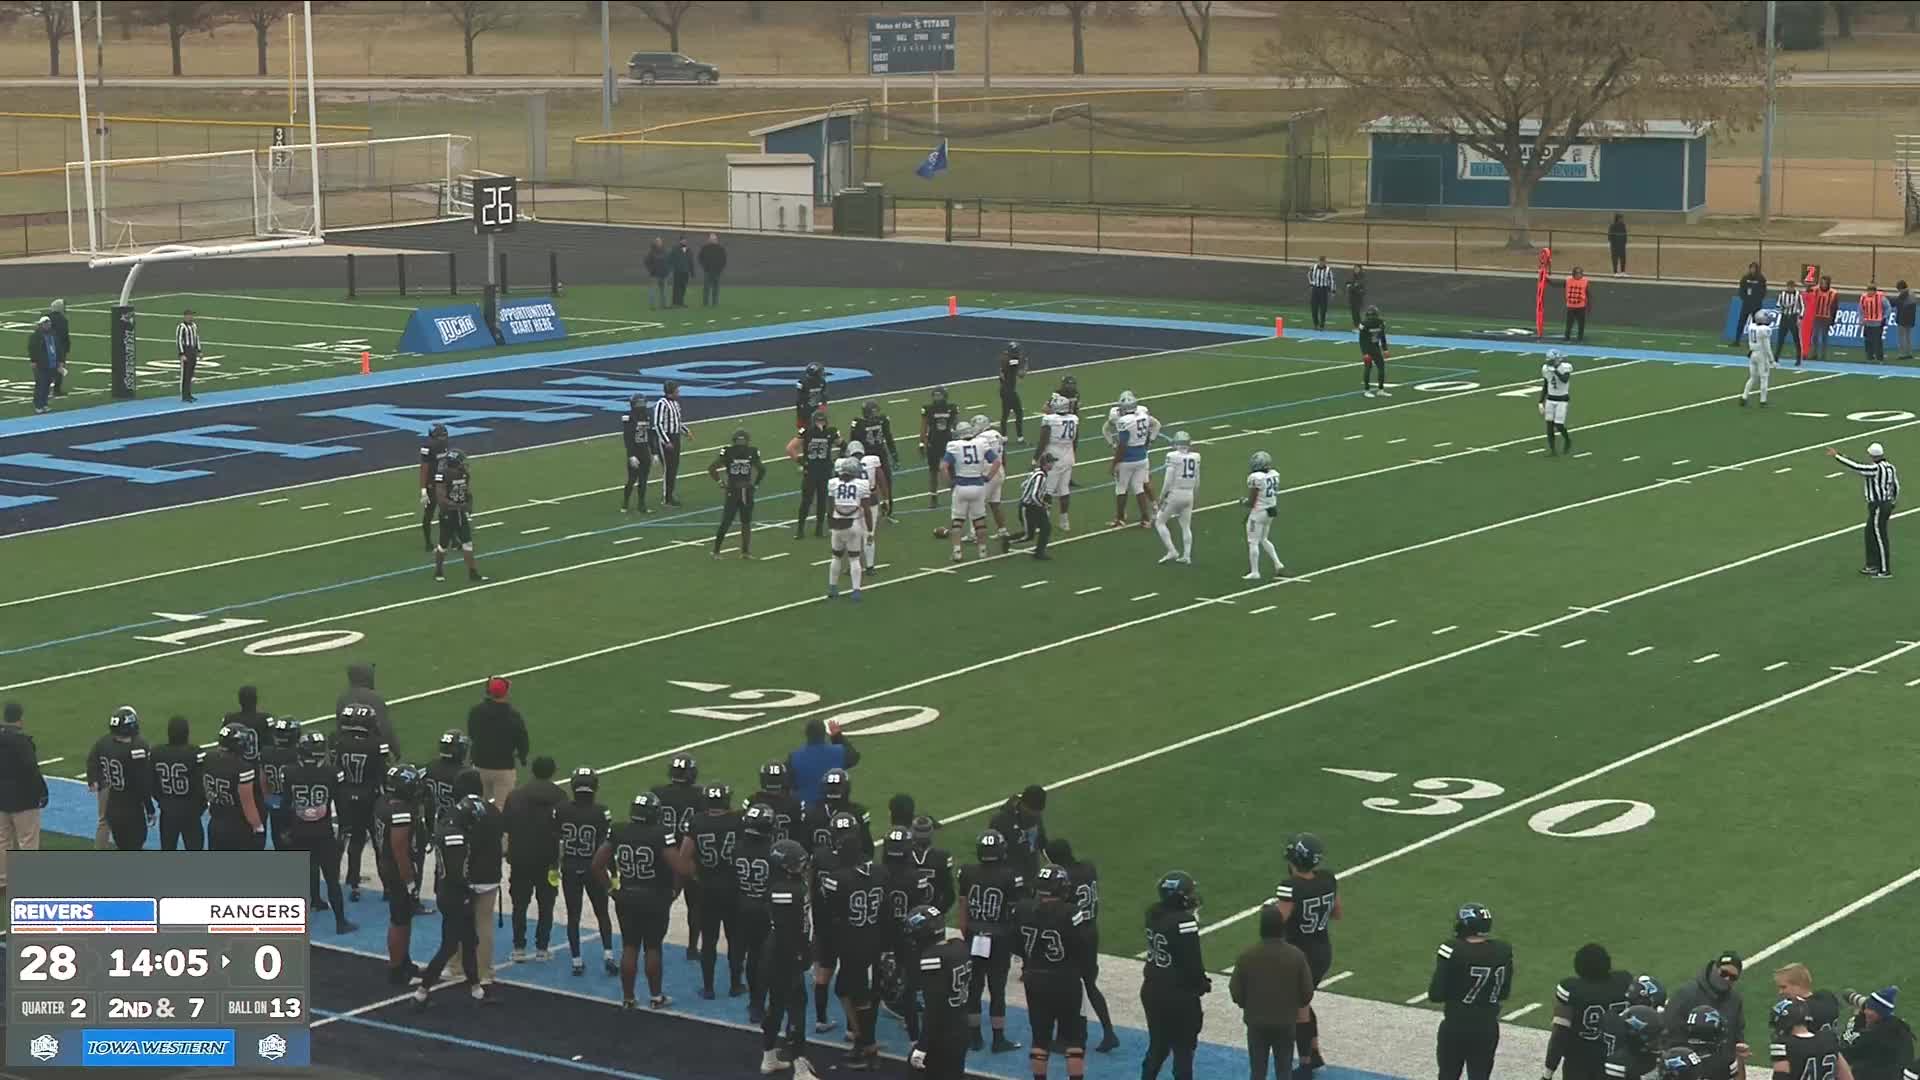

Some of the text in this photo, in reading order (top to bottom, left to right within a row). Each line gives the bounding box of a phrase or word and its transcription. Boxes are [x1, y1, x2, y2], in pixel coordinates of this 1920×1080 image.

[482, 186, 513, 225] 26
[1805, 265, 1816, 283] 2
[433, 314, 477, 345] NJCAA
[509, 317, 555, 335] START HERE
[1828, 325, 1860, 337] START
[1061, 420, 1076, 440] 78
[962, 444, 980, 465] 51
[1181, 458, 1196, 479] 19
[837, 483, 857, 500] 88
[155, 761, 190, 796] 26
[341, 753, 368, 784] 17
[768, 765, 780, 775] 16
[708, 788, 721, 798] 54
[561, 822, 597, 857] 29
[889, 831, 903, 841] 48
[981, 835, 995, 846] 40
[696, 831, 736, 868] 54
[616, 843, 656, 880] 92
[1038, 868, 1052, 879] 73
[967, 884, 1004, 921] 40
[1299, 891, 1335, 934] 57
[1020, 925, 1065, 962] 73
[1462, 966, 1505, 1004] 71
[1686, 1012, 1698, 1025] 11
[1800, 1053, 1837, 1080] 42
